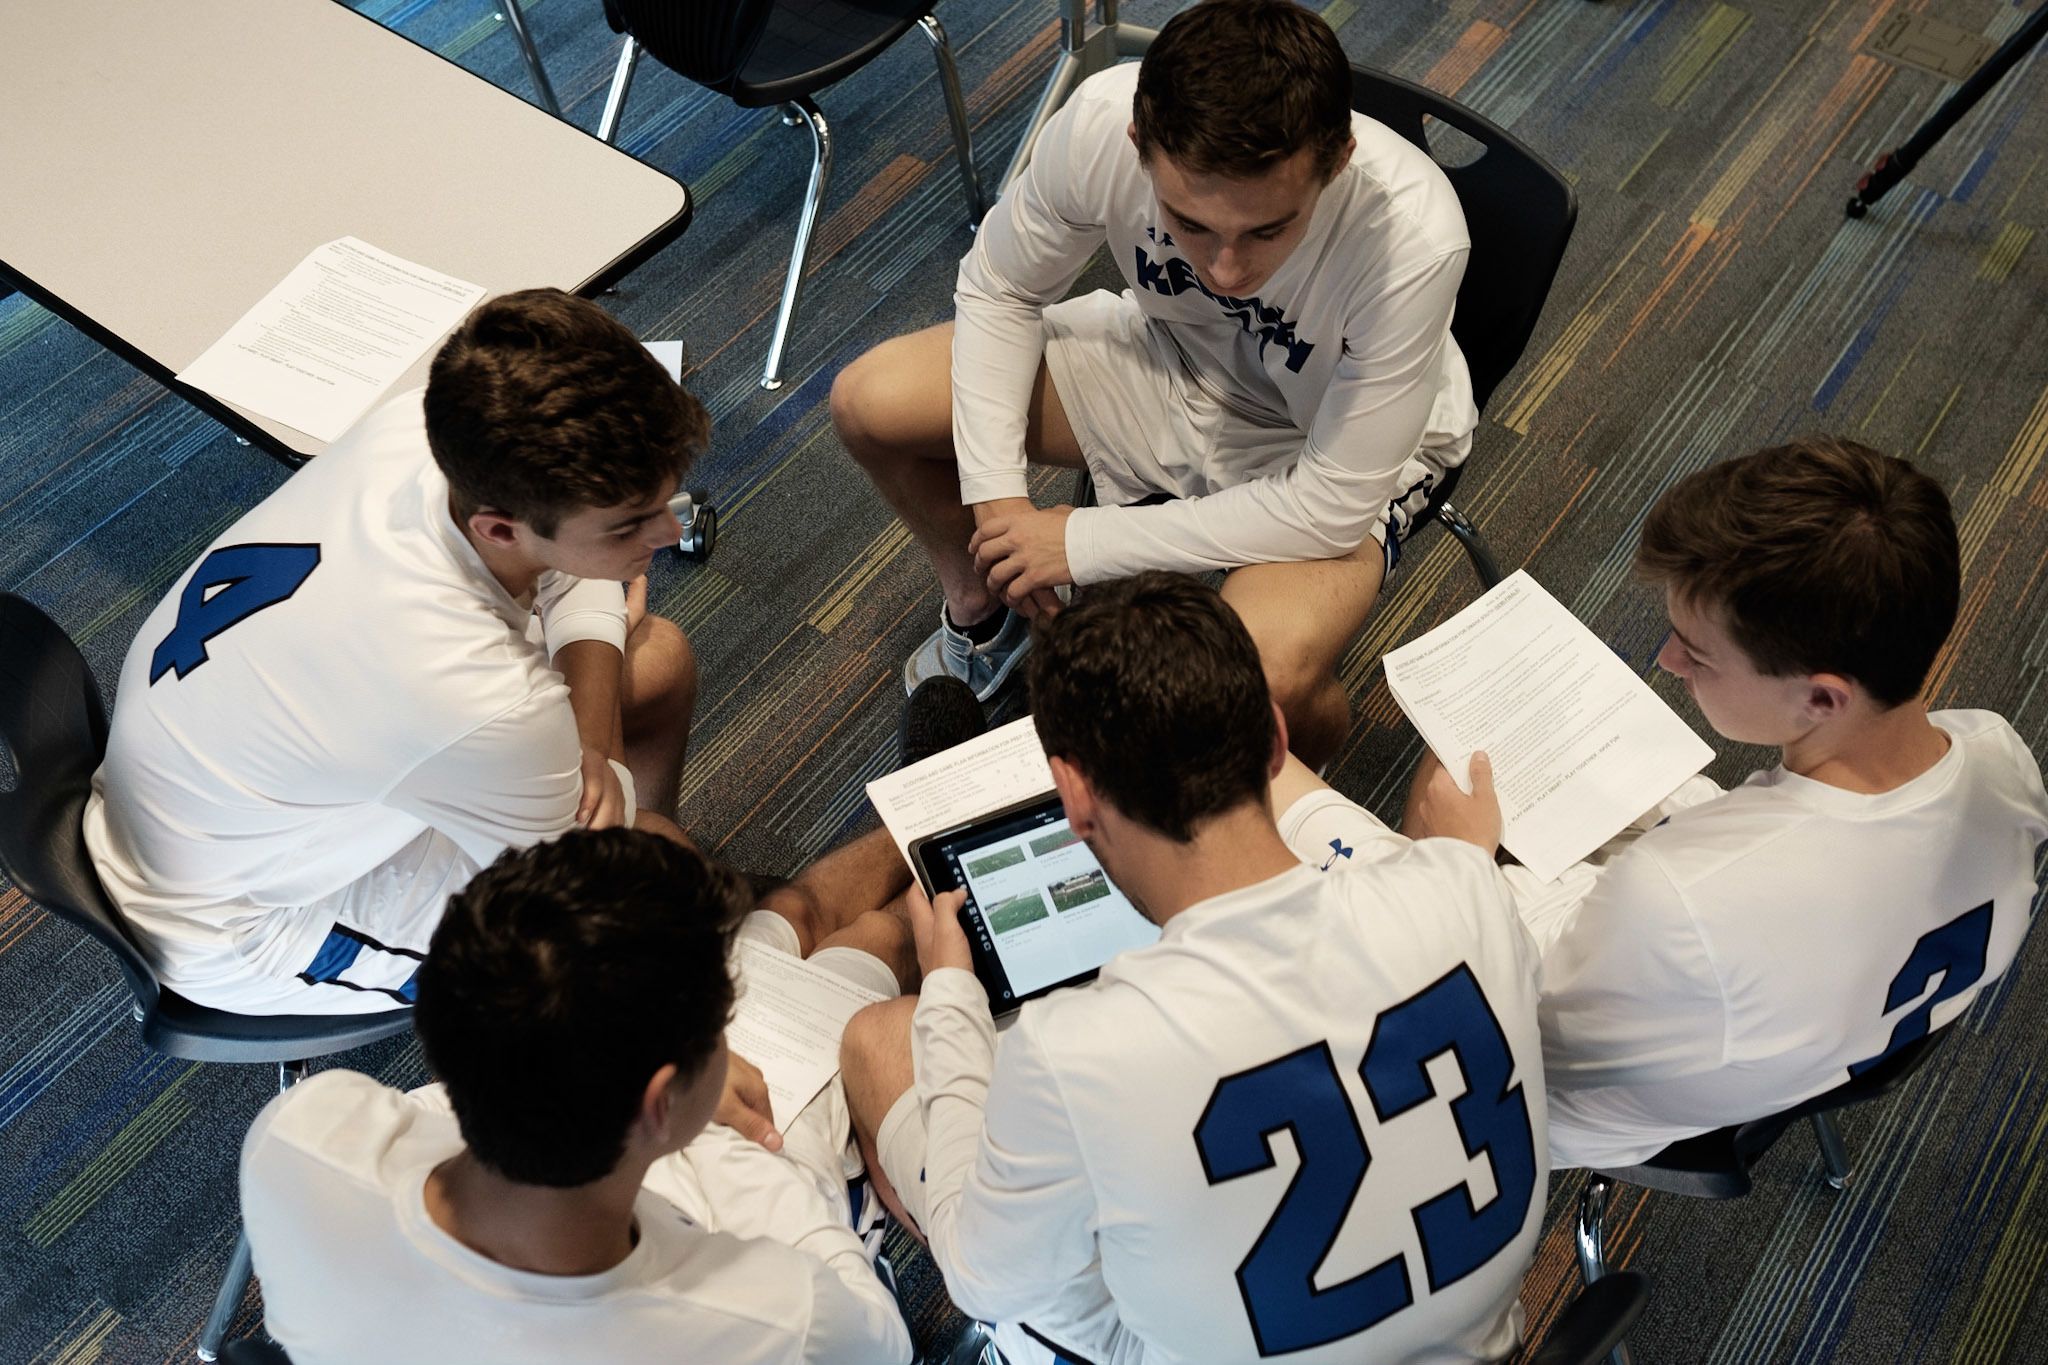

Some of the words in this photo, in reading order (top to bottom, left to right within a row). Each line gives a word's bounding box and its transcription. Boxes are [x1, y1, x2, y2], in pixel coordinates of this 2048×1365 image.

[150, 543, 321, 688] 4
[1456, 627, 1467, 636] FOR
[999, 738, 1009, 748] FOR
[1847, 899, 1994, 1079] 2
[1193, 961, 1537, 1358] 23
